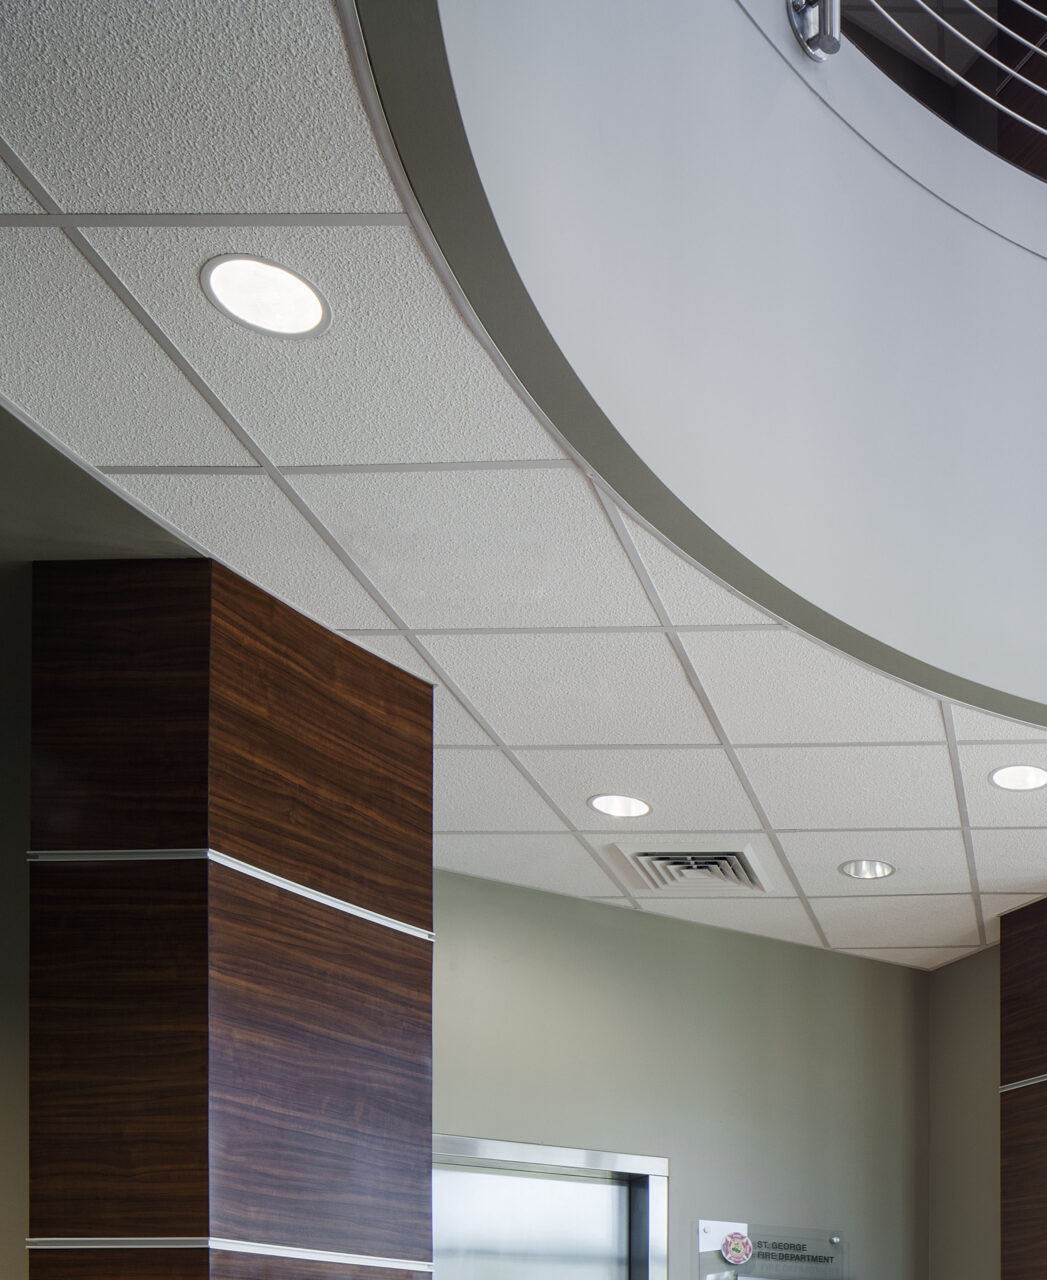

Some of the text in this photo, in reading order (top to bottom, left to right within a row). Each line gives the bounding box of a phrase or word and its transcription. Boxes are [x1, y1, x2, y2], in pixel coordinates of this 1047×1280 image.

[757, 1240, 770, 1249] ST.
[771, 1242, 807, 1251] GEORGE
[757, 1252, 835, 1264] FIRE DEPARTMENT
